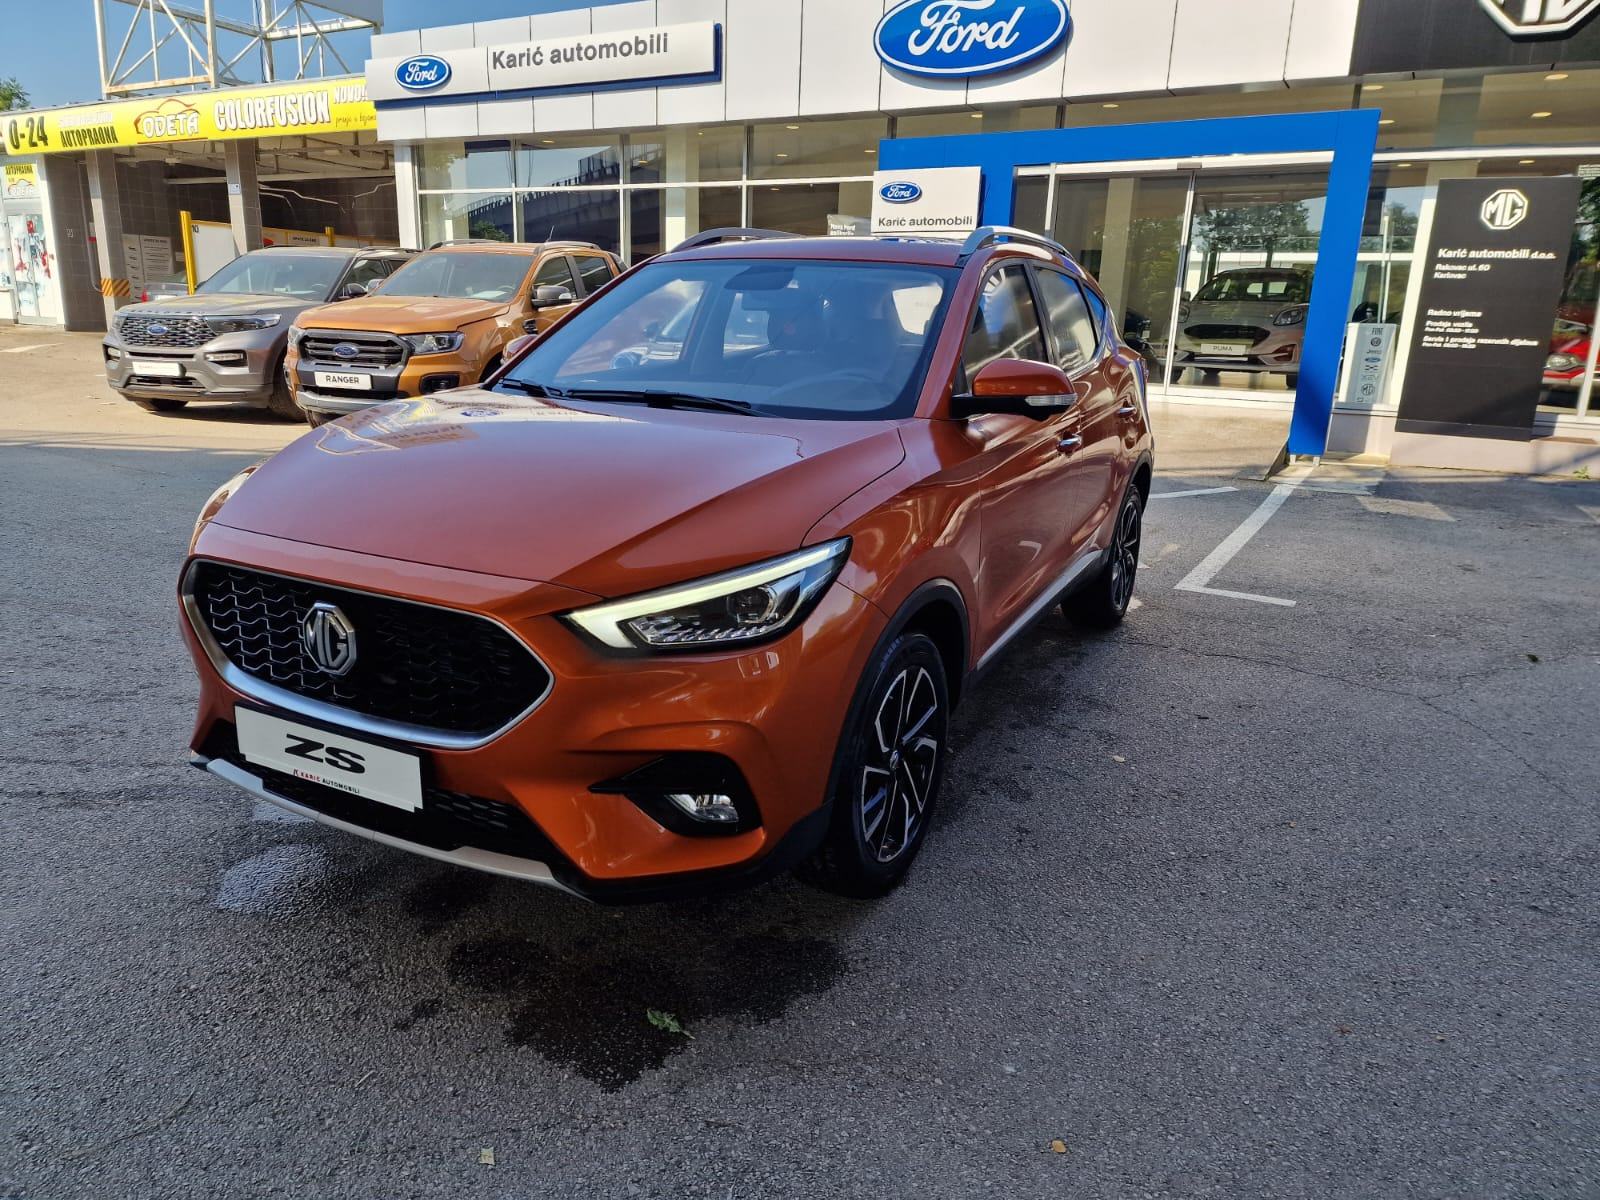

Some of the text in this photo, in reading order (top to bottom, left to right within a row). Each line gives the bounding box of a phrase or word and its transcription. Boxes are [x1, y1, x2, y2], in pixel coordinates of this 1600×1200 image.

[908, 0, 1025, 55] Ford
[492, 32, 669, 70] Karić automobili
[405, 60, 438, 83] Ford
[142, 112, 199, 138] ODETA
[214, 91, 331, 131] COLORFUSION
[9, 116, 48, 149] 0-24
[886, 184, 912, 198] Ford
[878, 215, 973, 227] Karić automobili
[1483, 190, 1526, 228] MG
[1438, 248, 1467, 258] Karić
[1468, 249, 1530, 259] automobili
[325, 375, 360, 384] RANGER
[303, 606, 353, 673] MG
[285, 733, 366, 774] ZS
